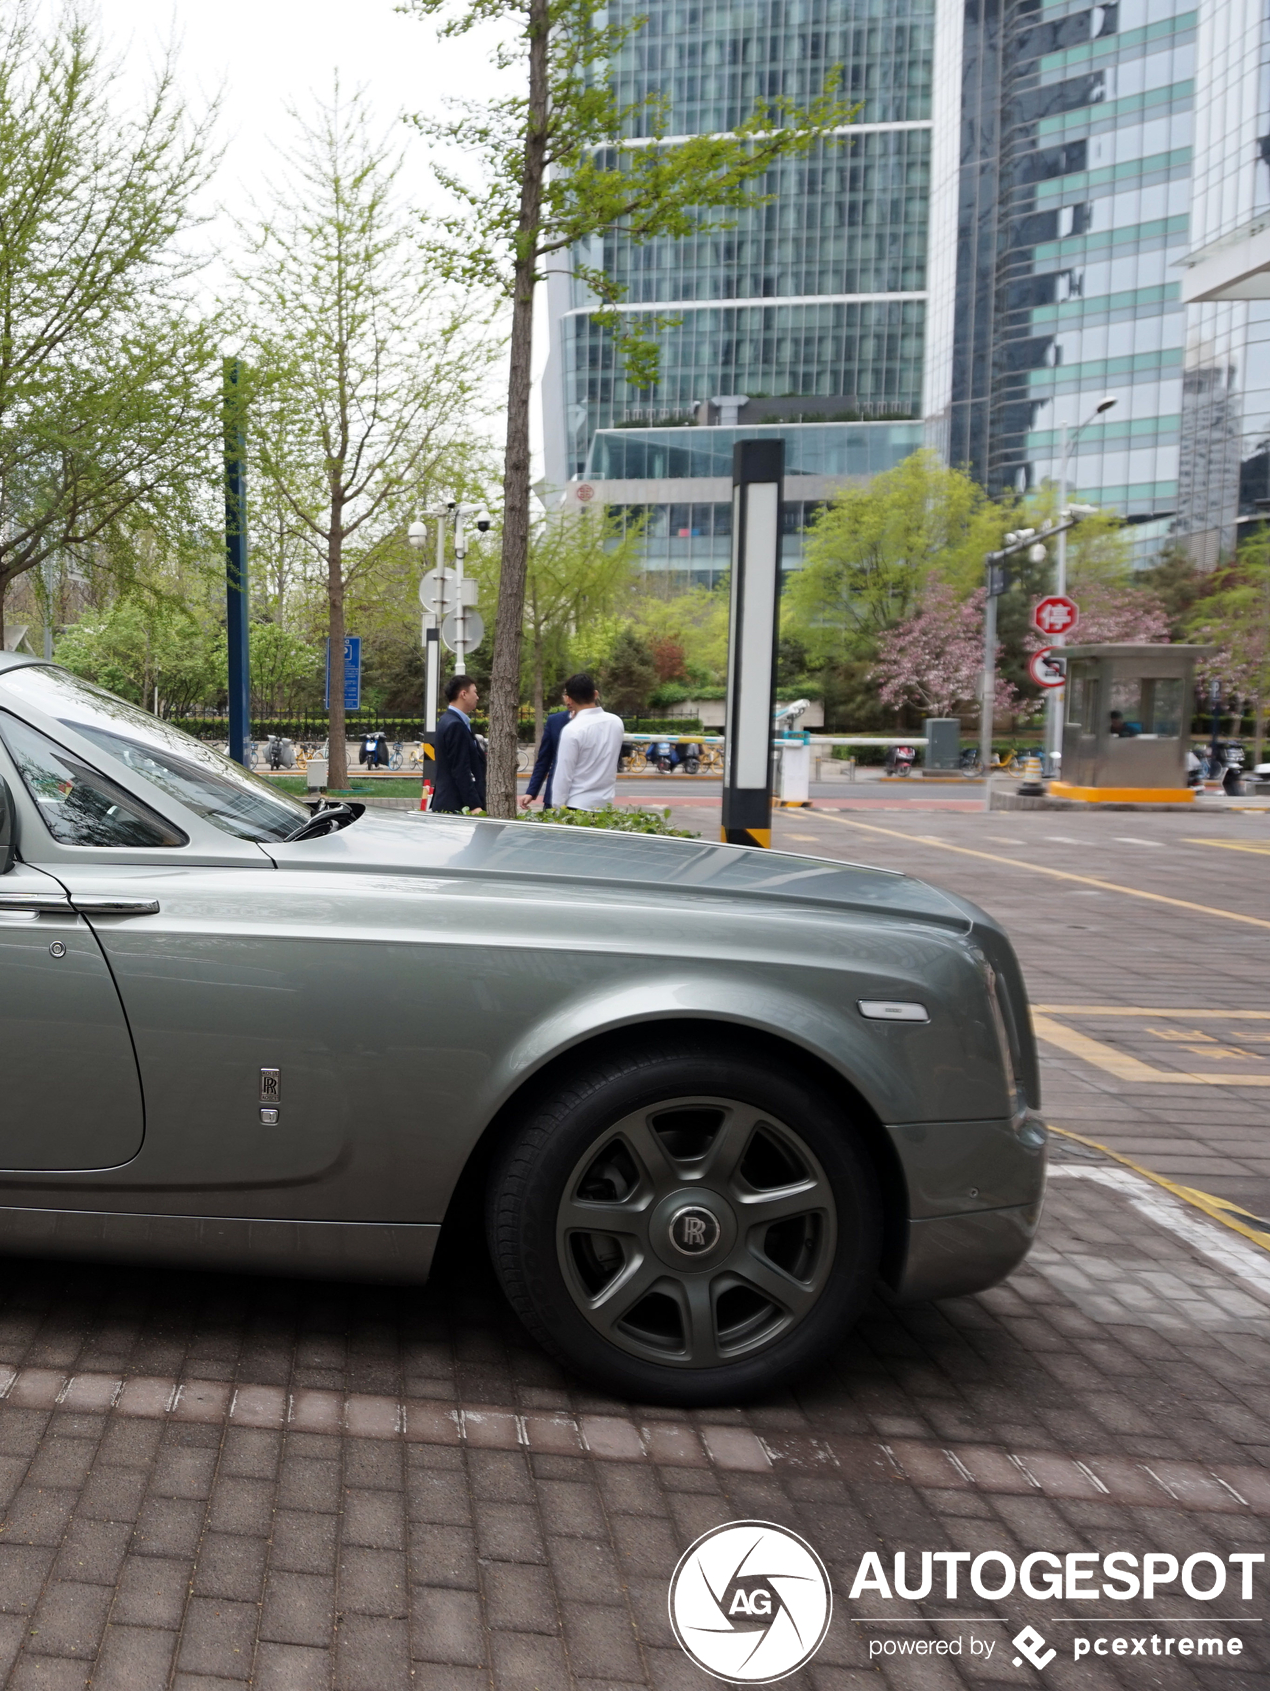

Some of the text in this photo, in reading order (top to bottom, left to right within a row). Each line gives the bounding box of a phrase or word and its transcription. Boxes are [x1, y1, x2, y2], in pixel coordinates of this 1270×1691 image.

[1042, 602, 1072, 630] 停
[263, 1076, 277, 1095] RR
[683, 1216, 706, 1245] RR
